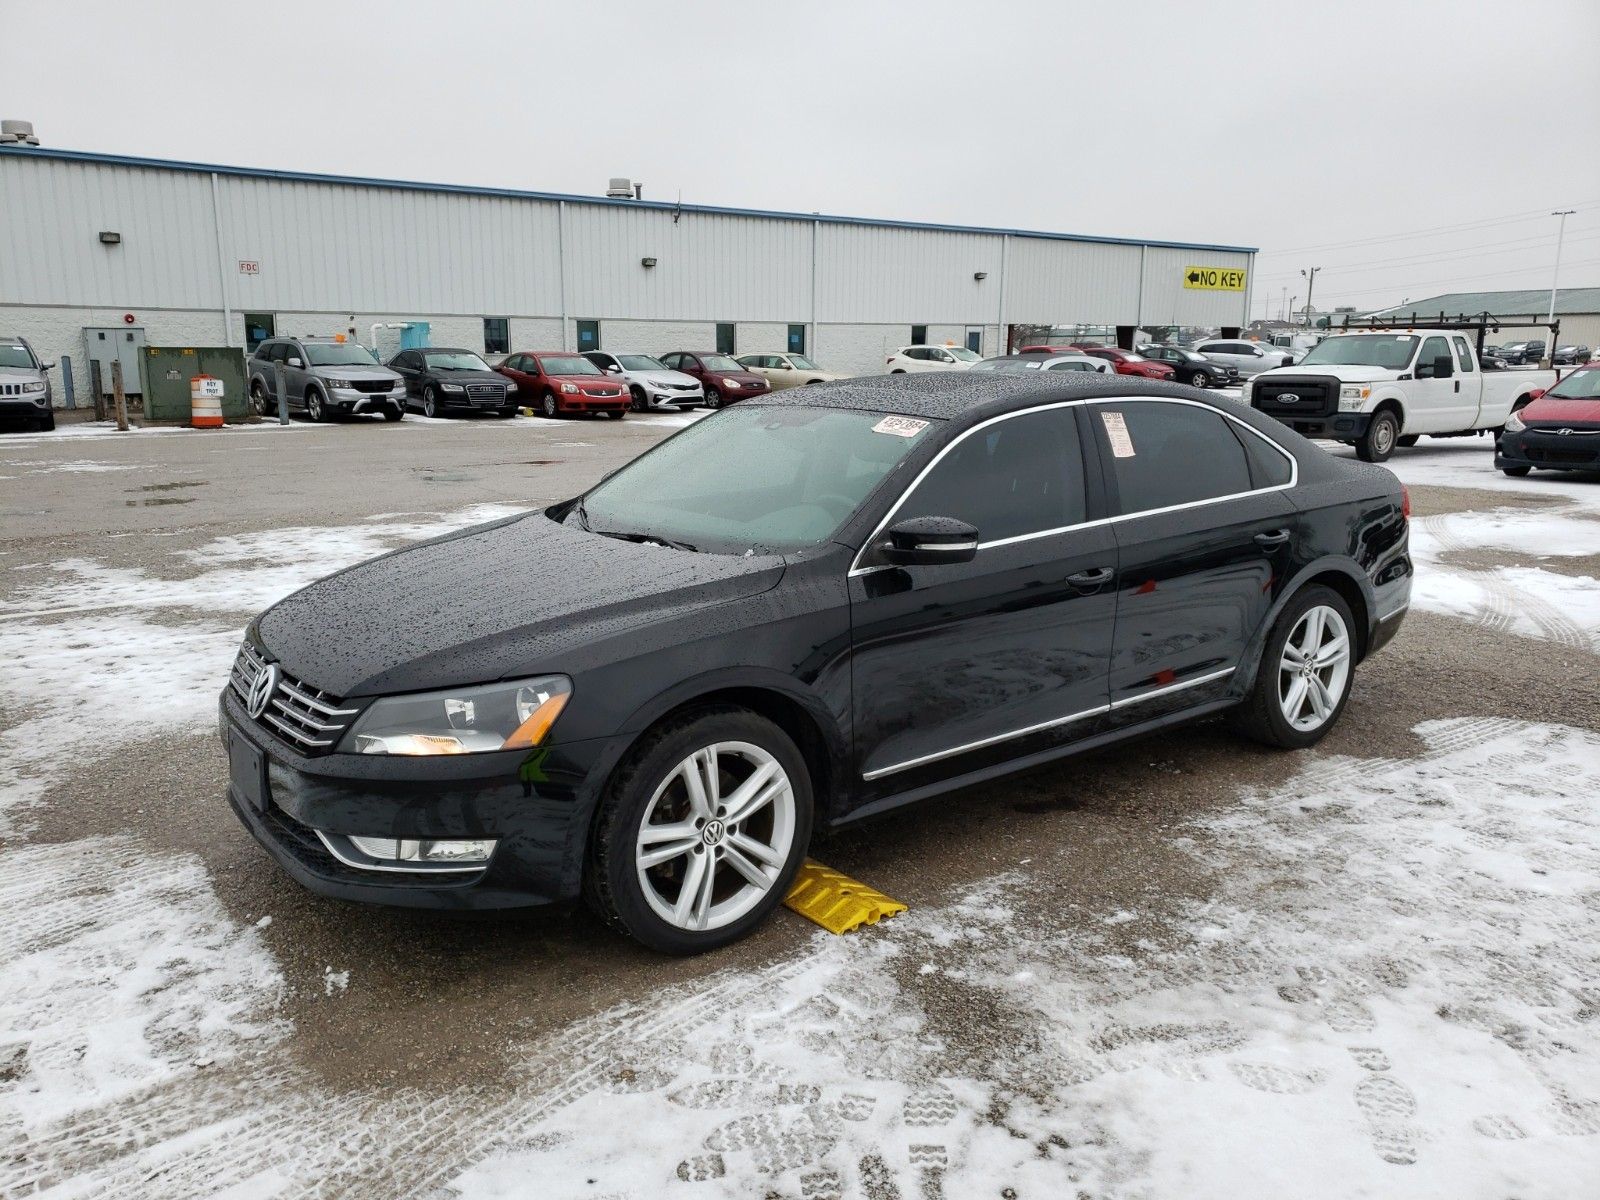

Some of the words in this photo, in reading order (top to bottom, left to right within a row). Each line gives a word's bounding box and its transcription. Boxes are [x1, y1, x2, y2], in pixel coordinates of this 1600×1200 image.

[241, 263, 256, 271] FDC
[1200, 270, 1217, 286] NO
[1220, 271, 1244, 287] KEY
